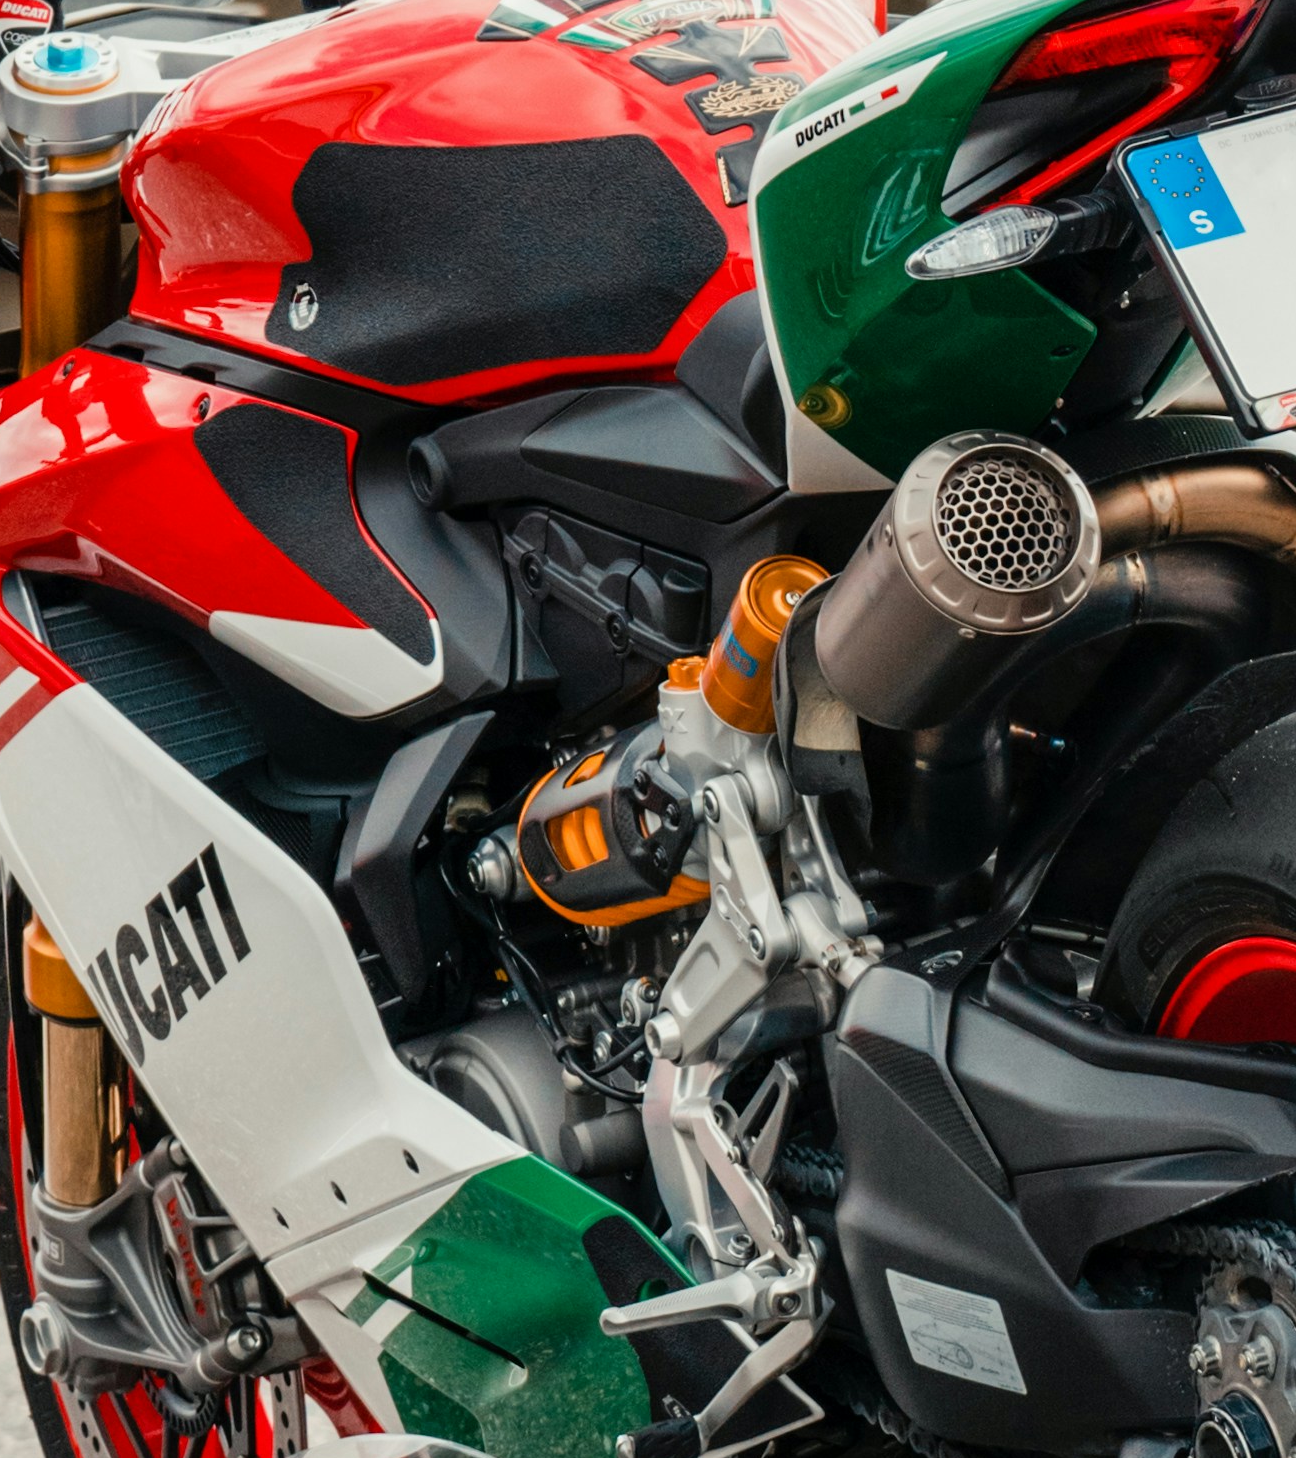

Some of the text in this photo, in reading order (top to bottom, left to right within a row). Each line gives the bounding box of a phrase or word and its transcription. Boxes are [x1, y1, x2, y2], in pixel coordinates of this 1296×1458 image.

[1, 1, 49, 20] DUCATI
[795, 109, 846, 148] DUCATI
[1189, 208, 1214, 236] S
[87, 841, 252, 1069] UCATI
